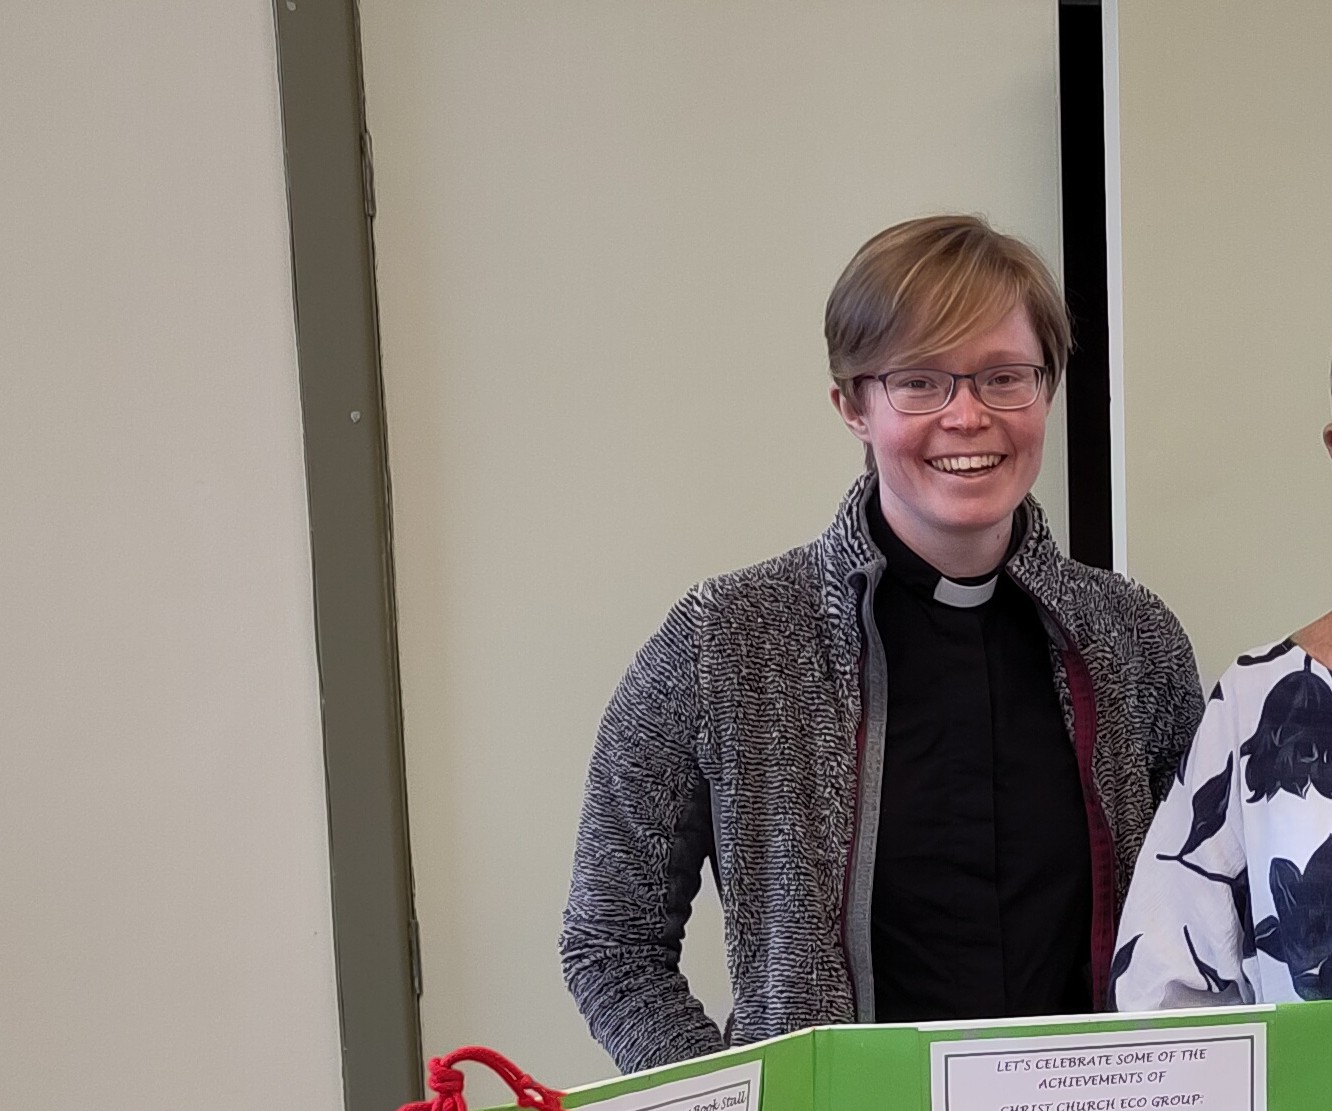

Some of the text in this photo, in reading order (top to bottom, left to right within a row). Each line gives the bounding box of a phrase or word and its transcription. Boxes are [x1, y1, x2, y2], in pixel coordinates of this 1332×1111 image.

[997, 1048, 1207, 1072] LET'S CELEBRATE SOME OF THE
[1039, 1071, 1166, 1089] ACHIEVEMENTS OF
[1120, 1097, 1147, 1109] ECO
